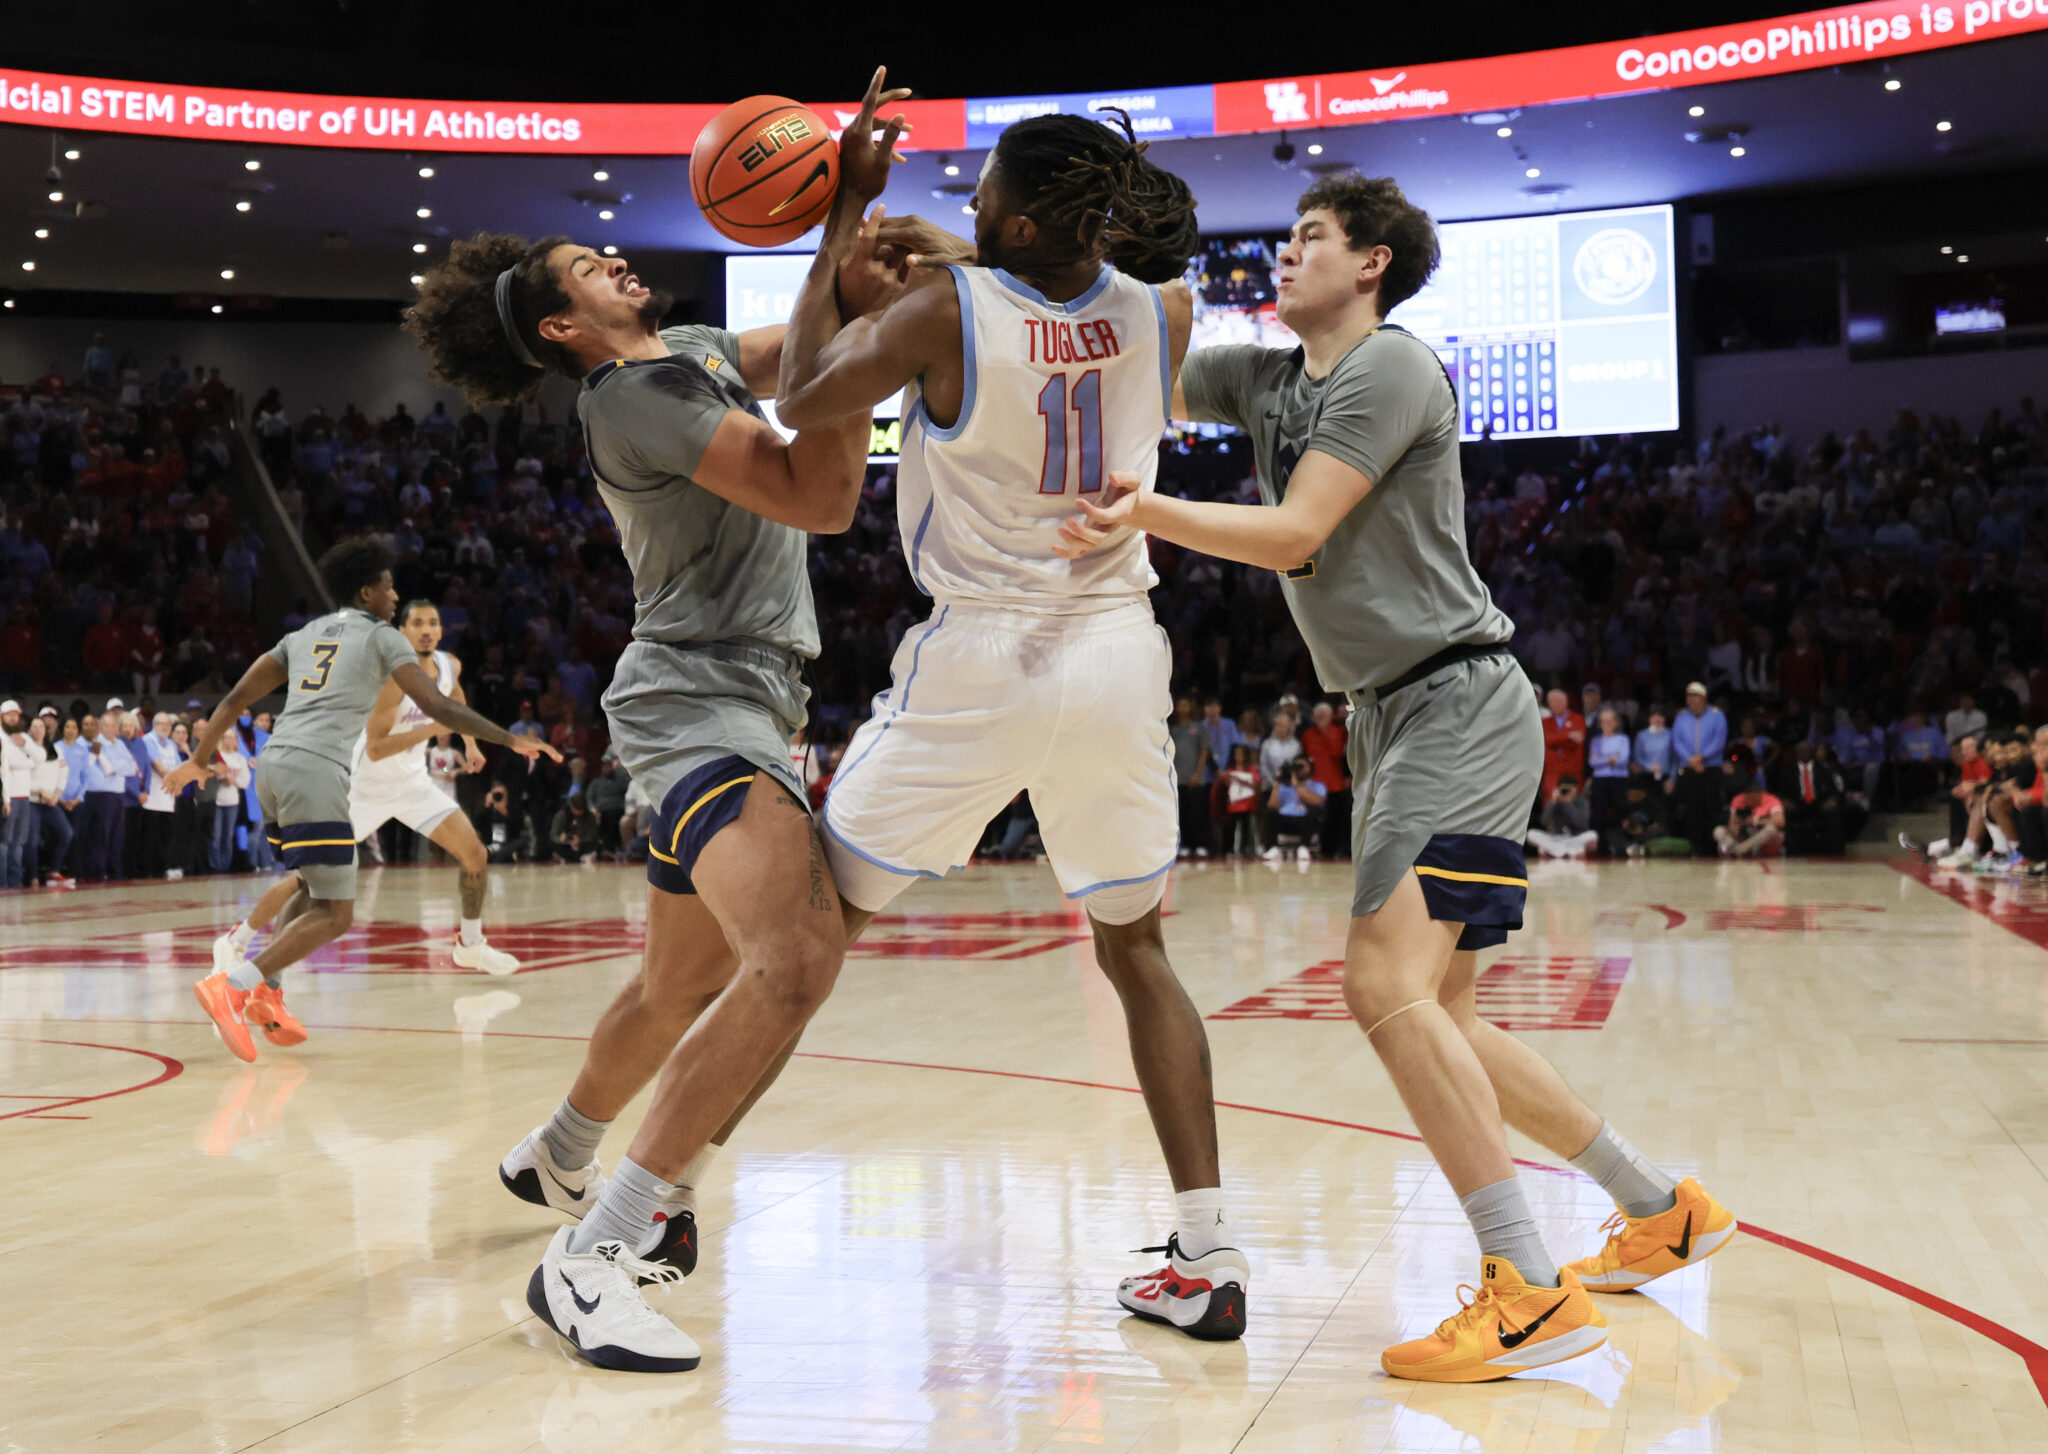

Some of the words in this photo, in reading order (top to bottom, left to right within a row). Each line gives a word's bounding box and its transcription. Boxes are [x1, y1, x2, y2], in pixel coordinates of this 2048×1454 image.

[1616, 13, 1912, 81] ConocoPhillips
[1920, 3, 1955, 36] is
[80, 87, 174, 123] STEM
[184, 96, 313, 132] Partner
[319, 106, 357, 134] of
[363, 107, 416, 137] UH
[423, 110, 581, 141] Athletics
[1328, 89, 1449, 115] ConocoPhillips
[737, 117, 813, 173] ELITE
[1024, 319, 1120, 364] TUGLER
[1038, 369, 1103, 495] 11
[300, 641, 342, 693] 3
